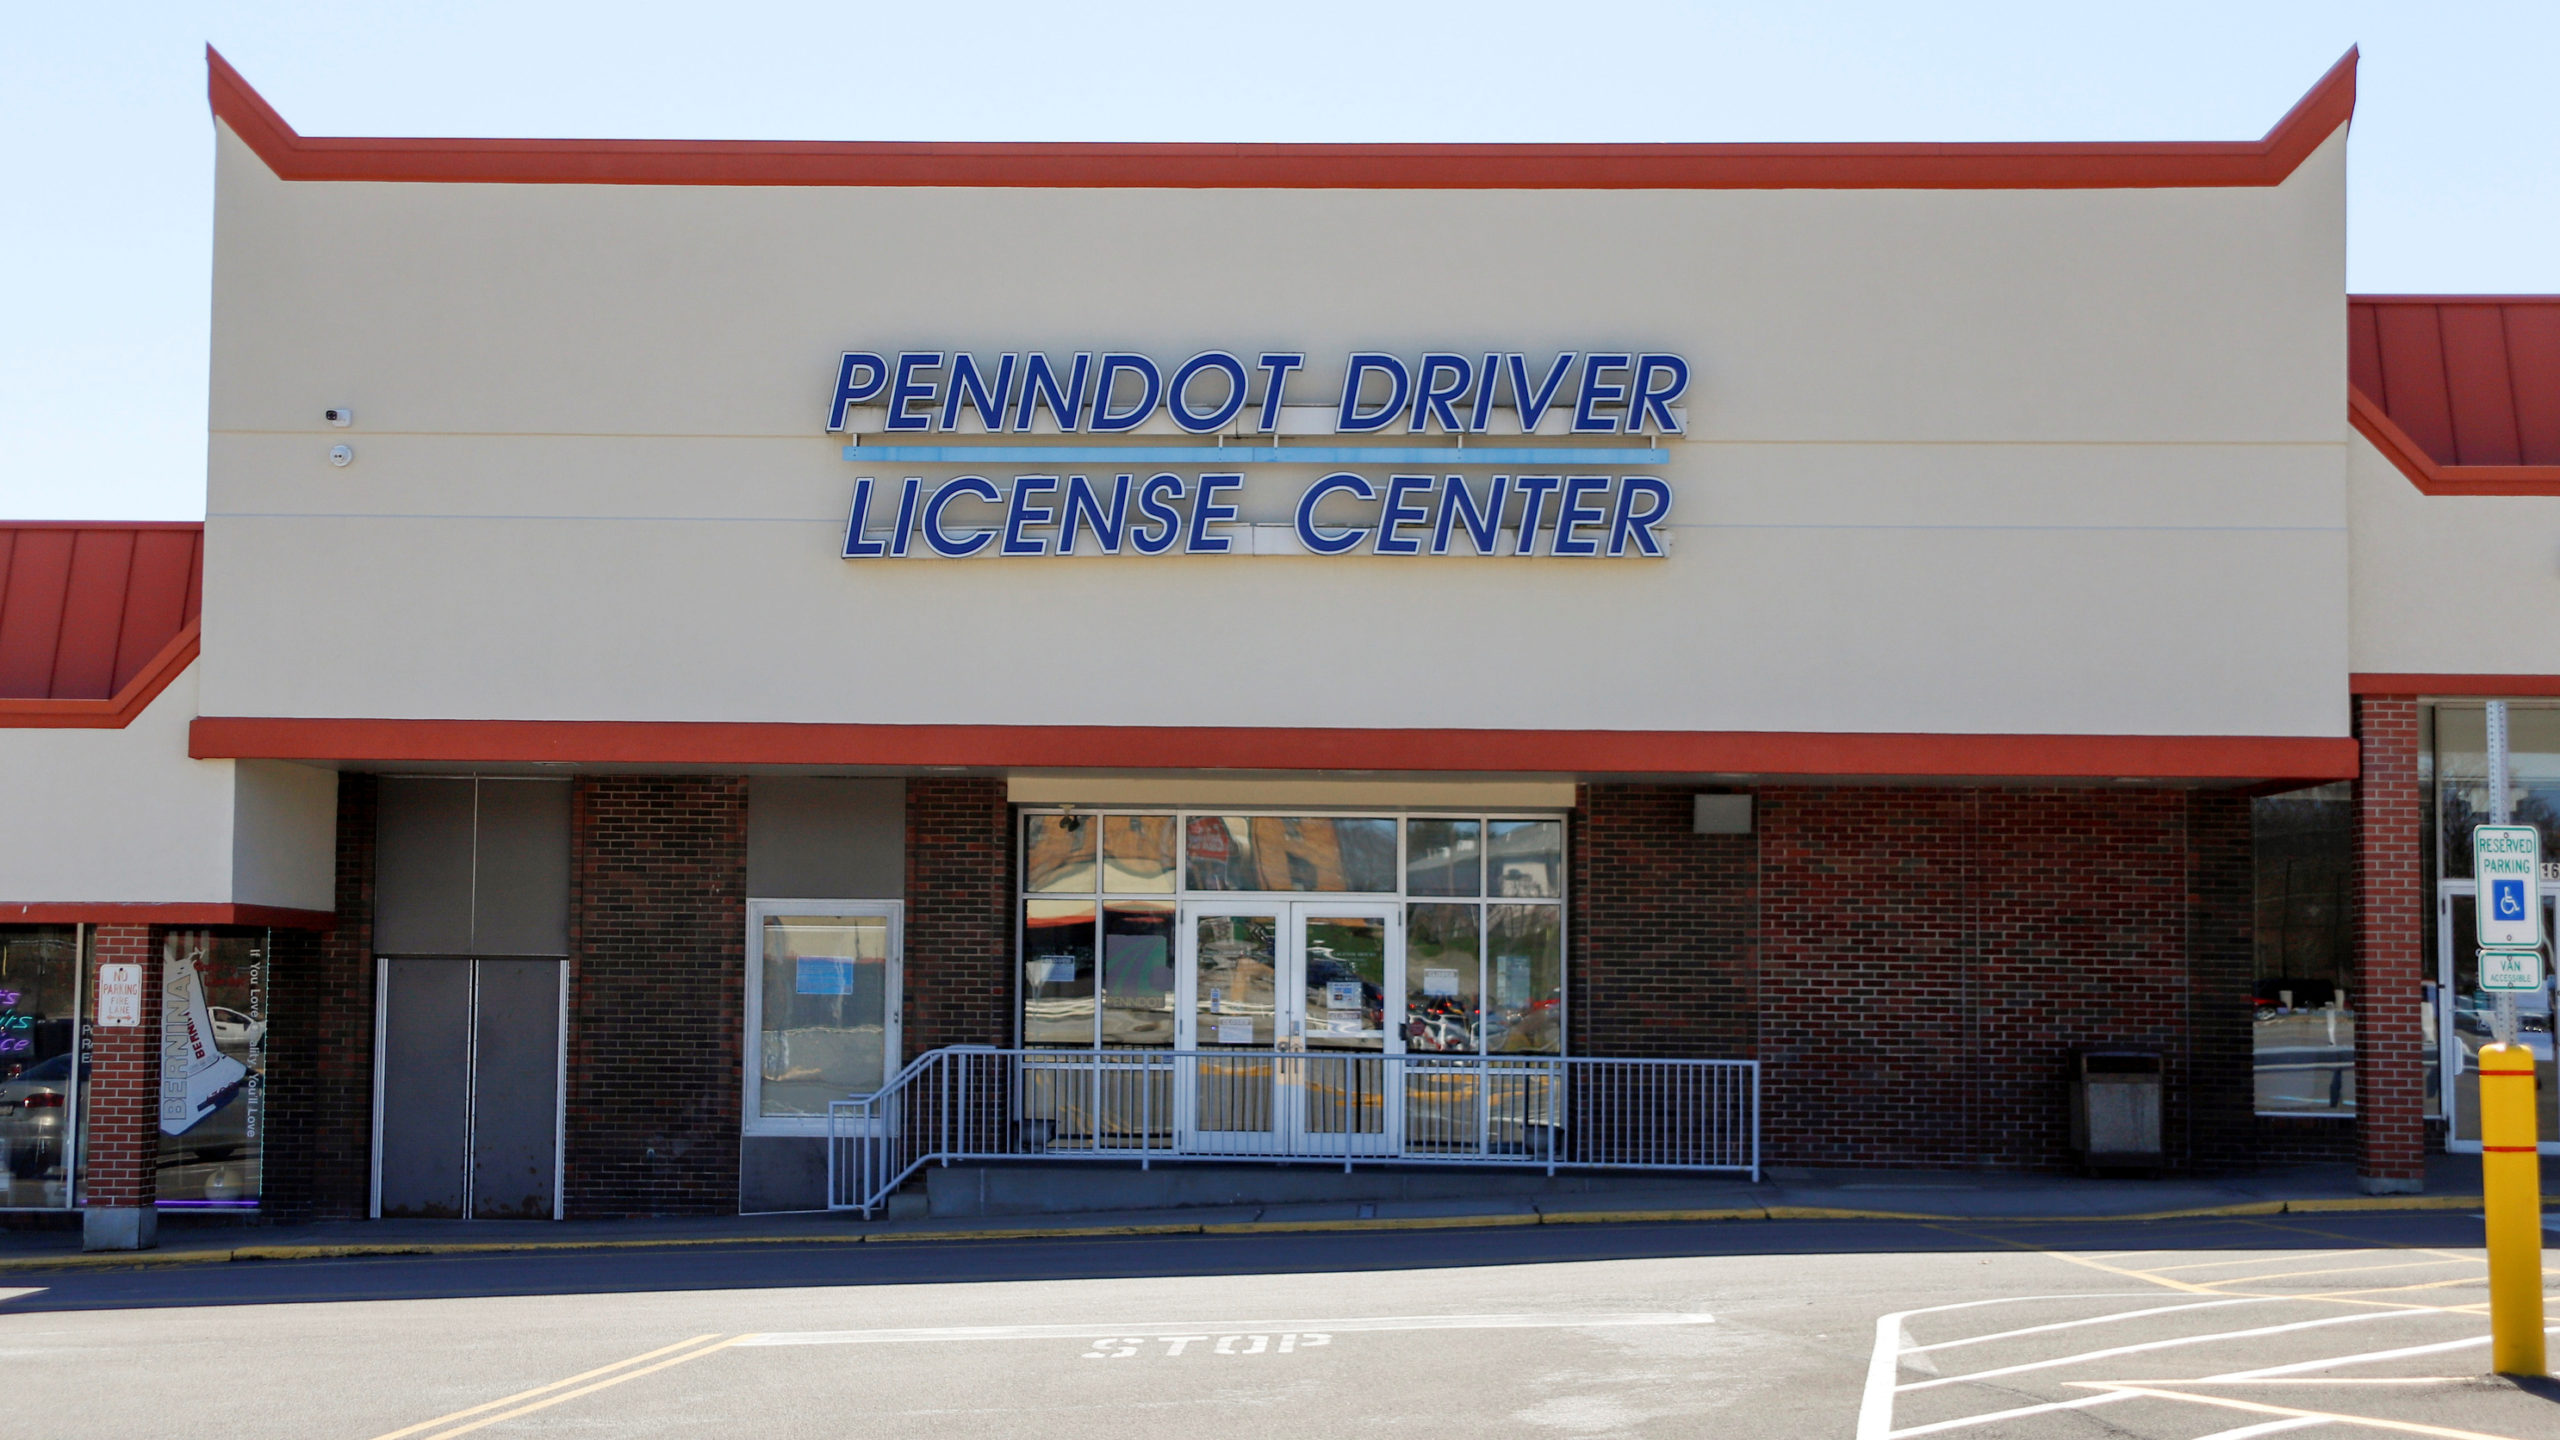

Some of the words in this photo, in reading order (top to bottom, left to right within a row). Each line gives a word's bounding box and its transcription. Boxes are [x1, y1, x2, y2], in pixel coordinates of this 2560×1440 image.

[825, 351, 1305, 434] PENNDOT
[1335, 351, 1690, 434] DRIVER
[841, 472, 1245, 559] LICENSE
[1294, 471, 1672, 558] CENTER
[2479, 838, 2533, 853] RESERVED
[2484, 859, 2530, 874] PARKING
[249, 948, 261, 957] If
[249, 962, 261, 984] You
[2500, 961, 2521, 971] VAN
[113, 970, 128, 982] NO
[103, 983, 138, 995] PARKING
[110, 996, 129, 1005] FIRE
[249, 989, 261, 1018] Love
[1106, 996, 1164, 1008] PENNDOT
[109, 1006, 130, 1014] LANE
[162, 974, 191, 1120] BERNINA
[246, 1109, 258, 1138] Love
[1080, 1333, 1333, 1358] STOP
